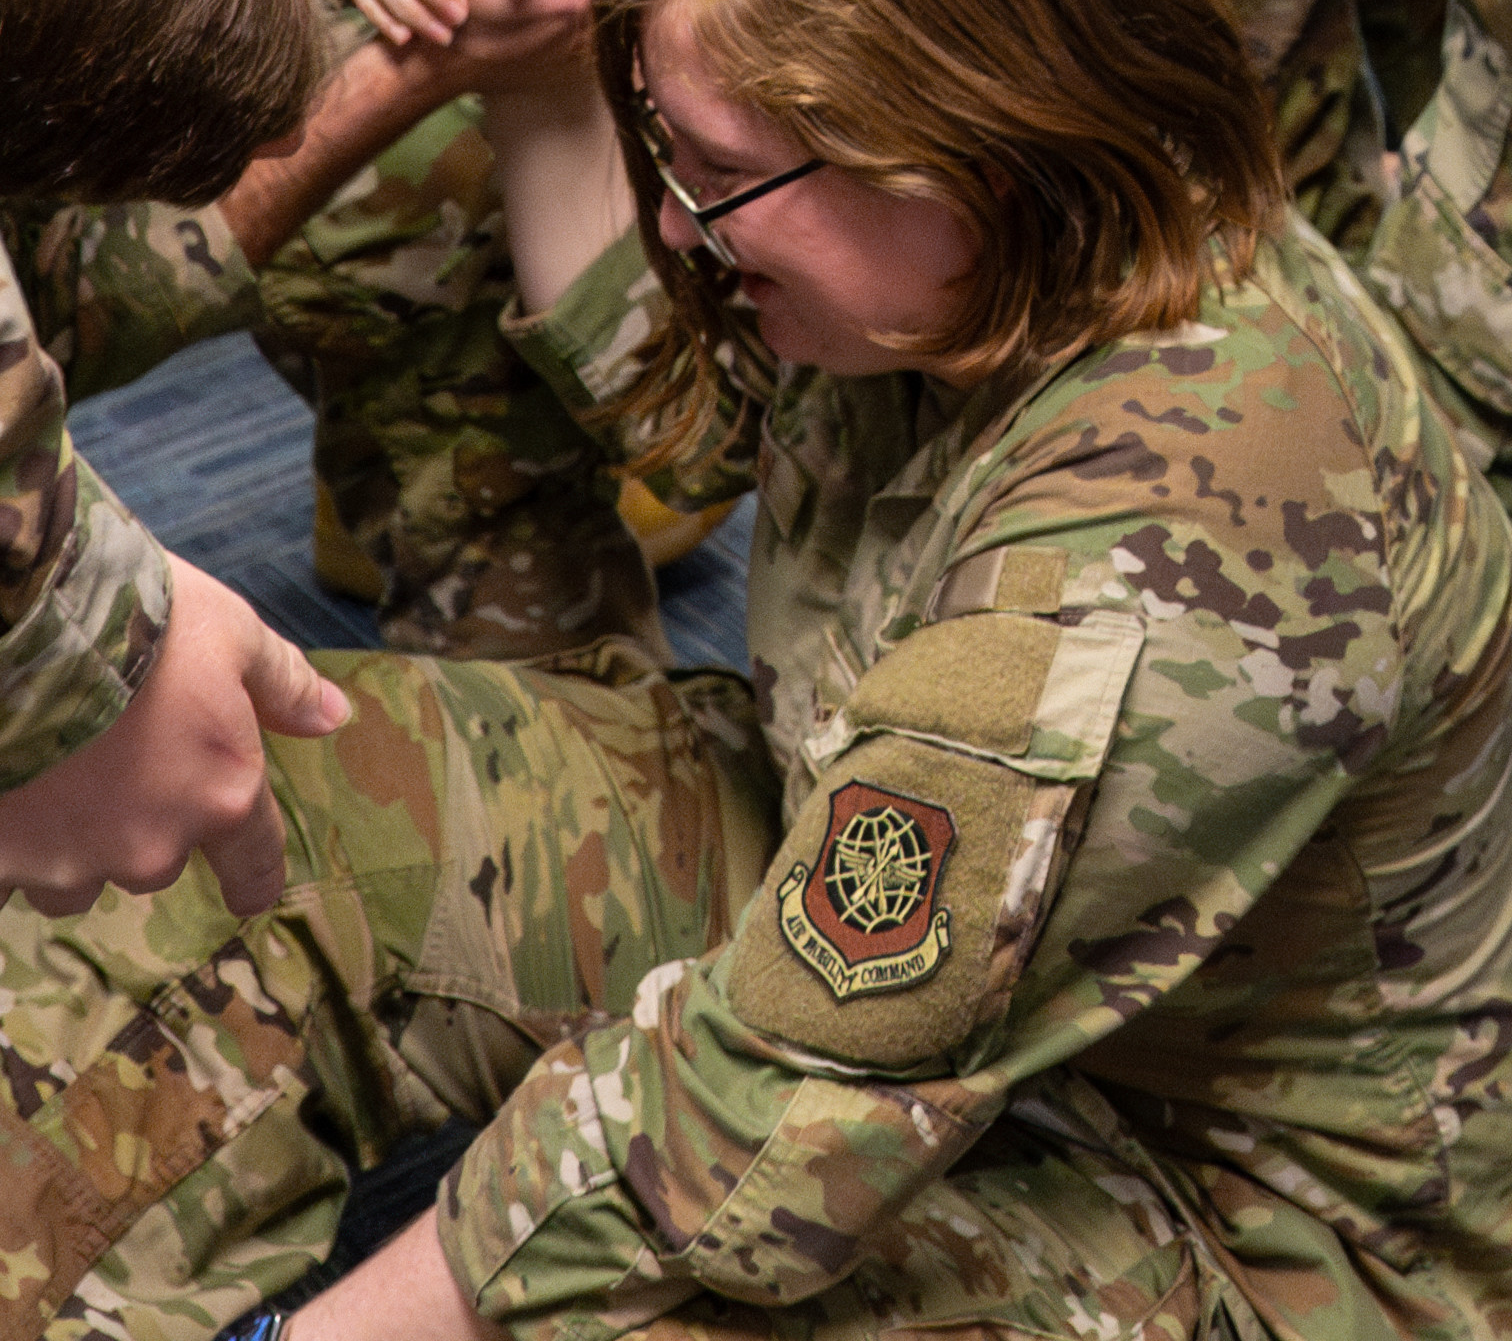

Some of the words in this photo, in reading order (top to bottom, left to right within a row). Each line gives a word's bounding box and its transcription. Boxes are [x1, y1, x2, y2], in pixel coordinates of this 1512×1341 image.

[786, 915, 807, 940] AIR
[802, 935, 858, 992] MOBILITY
[861, 954, 926, 985] COMMAND
